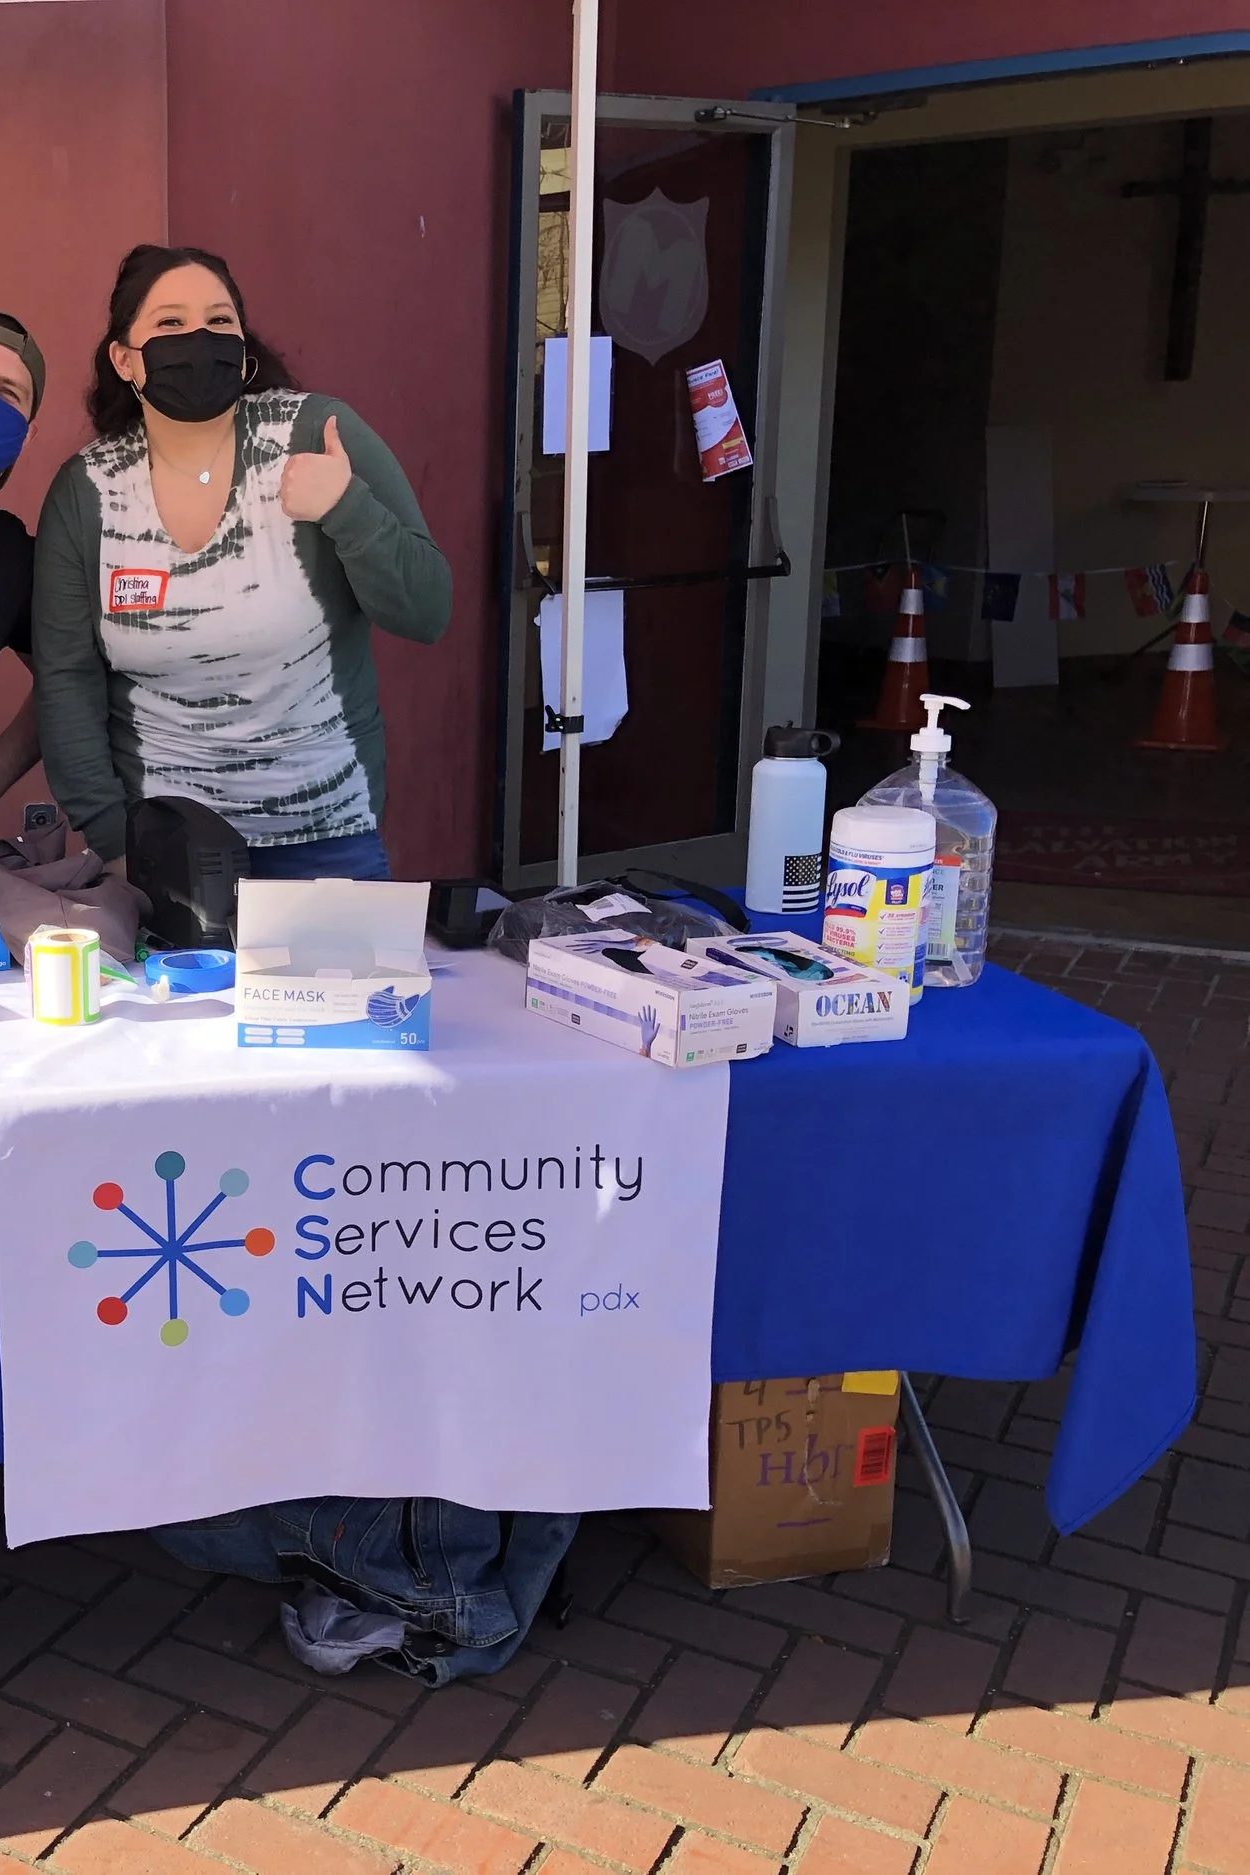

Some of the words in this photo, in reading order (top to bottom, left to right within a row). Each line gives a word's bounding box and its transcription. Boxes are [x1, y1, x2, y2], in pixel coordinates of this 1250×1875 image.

[826, 872, 870, 905] Lysol
[243, 987, 281, 1001] FACE
[283, 989, 326, 1003] MASK
[815, 991, 893, 1017] OCEAN
[689, 1011, 708, 1021] Nitrile
[708, 1010, 726, 1019] Exam
[726, 1007, 749, 1016] Gloves
[689, 1018, 734, 1030] POWDER-FREE
[399, 1031, 417, 1045] 50
[293, 1143, 644, 1202] Community
[294, 1208, 547, 1261] Services
[296, 1267, 544, 1319] Network
[579, 1284, 641, 1317] pdx
